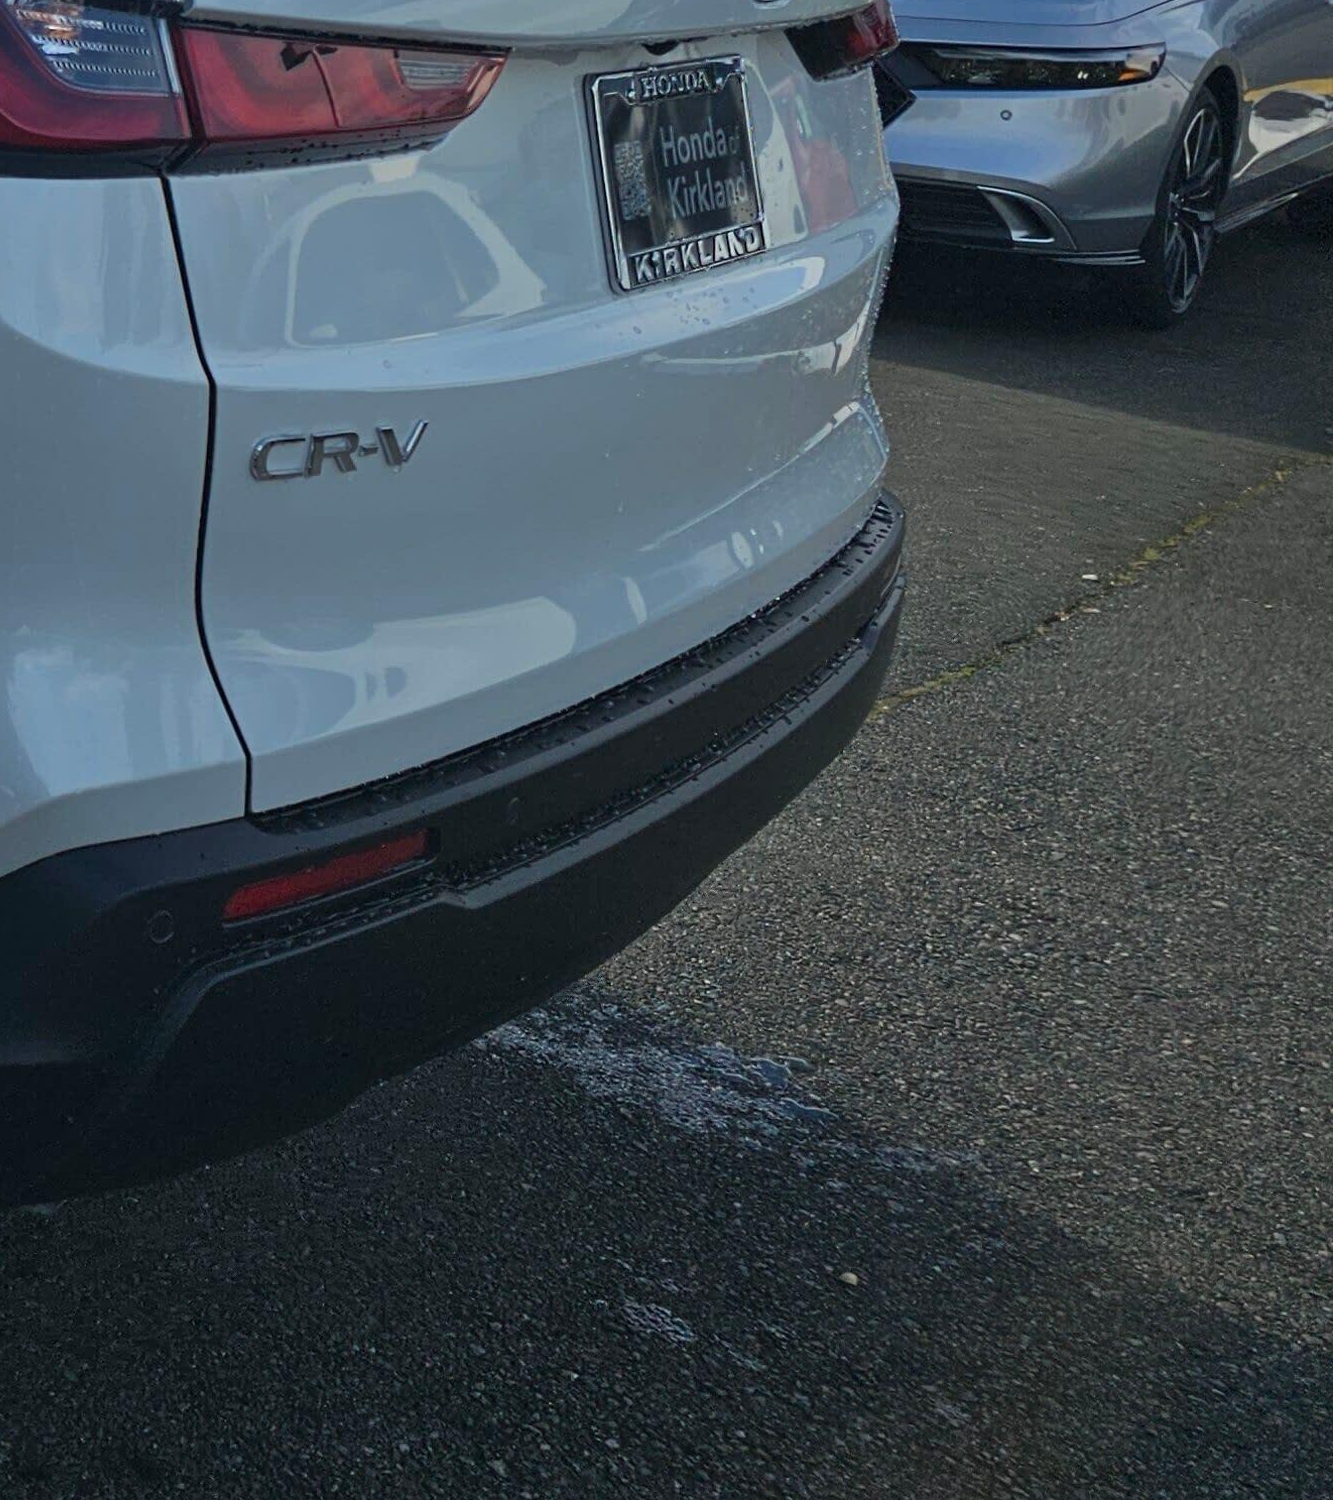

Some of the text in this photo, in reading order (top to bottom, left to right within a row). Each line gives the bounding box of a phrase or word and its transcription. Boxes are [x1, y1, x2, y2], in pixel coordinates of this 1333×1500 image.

[640, 69, 711, 98] HONDA
[659, 116, 727, 168] Honda
[666, 161, 750, 221] Kirkland
[635, 226, 762, 284] KIRKLAND
[249, 419, 429, 482] CR-V
